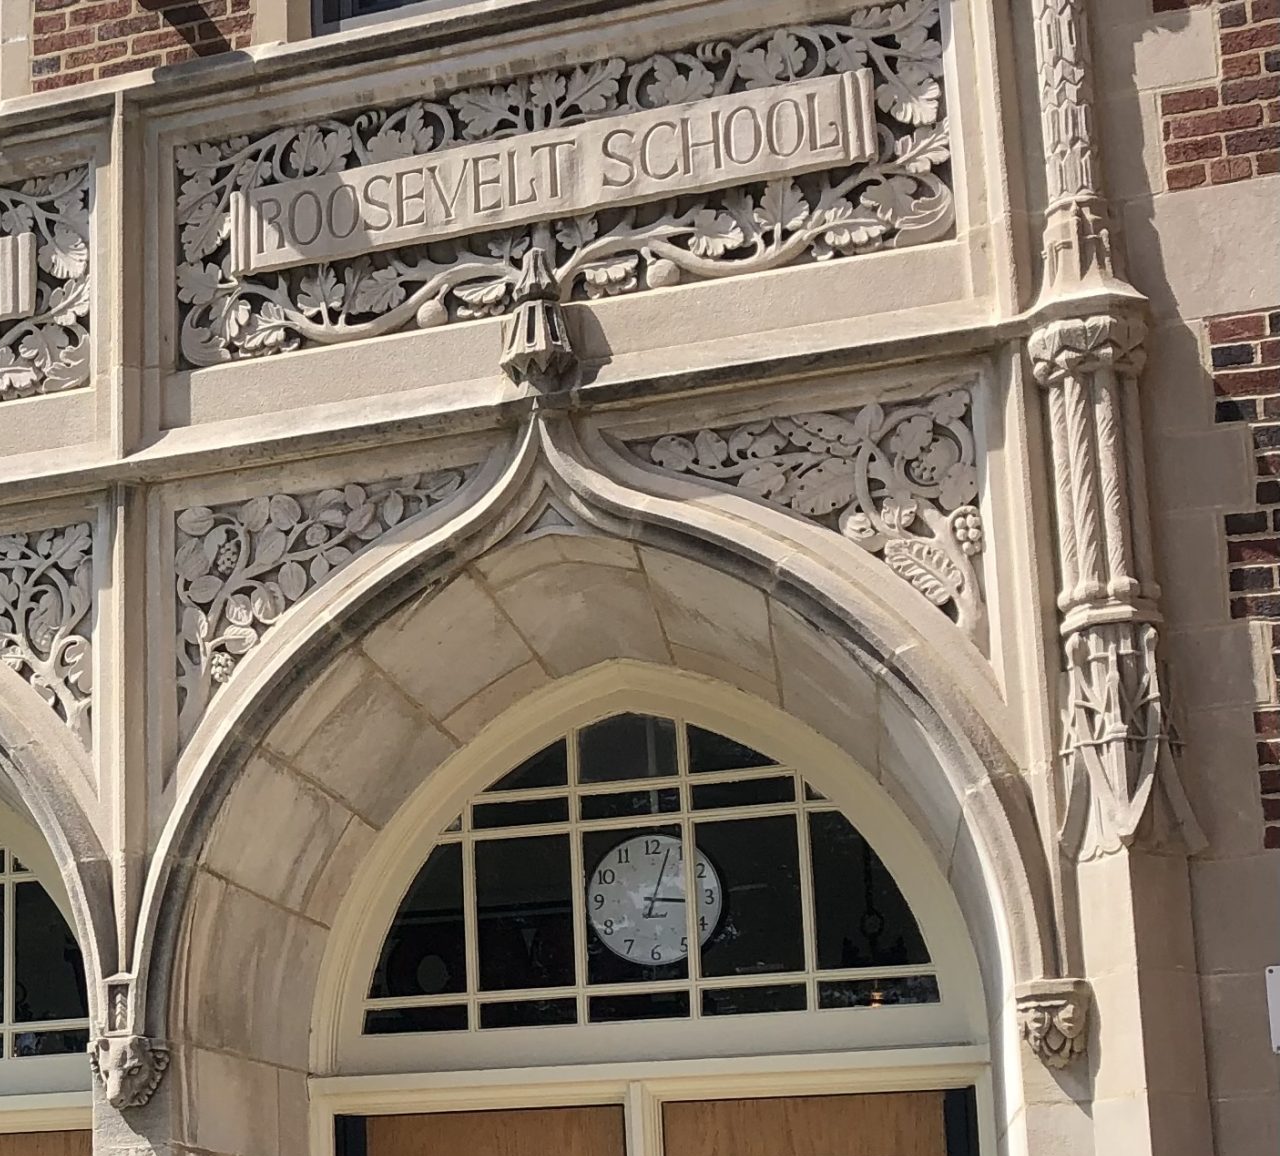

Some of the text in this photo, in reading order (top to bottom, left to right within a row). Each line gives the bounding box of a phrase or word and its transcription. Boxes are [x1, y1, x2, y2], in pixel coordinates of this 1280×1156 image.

[255, 91, 840, 255] ROOSEVELT SCHOOL
[617, 847, 630, 864] 11
[644, 839, 661, 855] 12
[597, 868, 616, 885] 10
[696, 862, 707, 879] 2
[594, 893, 605, 911] 9
[704, 888, 715, 905] 3
[603, 919, 614, 936] 8
[699, 915, 709, 932] 4
[623, 939, 635, 955] 7
[650, 944, 662, 961] 6
[680, 936, 688, 953] 5
